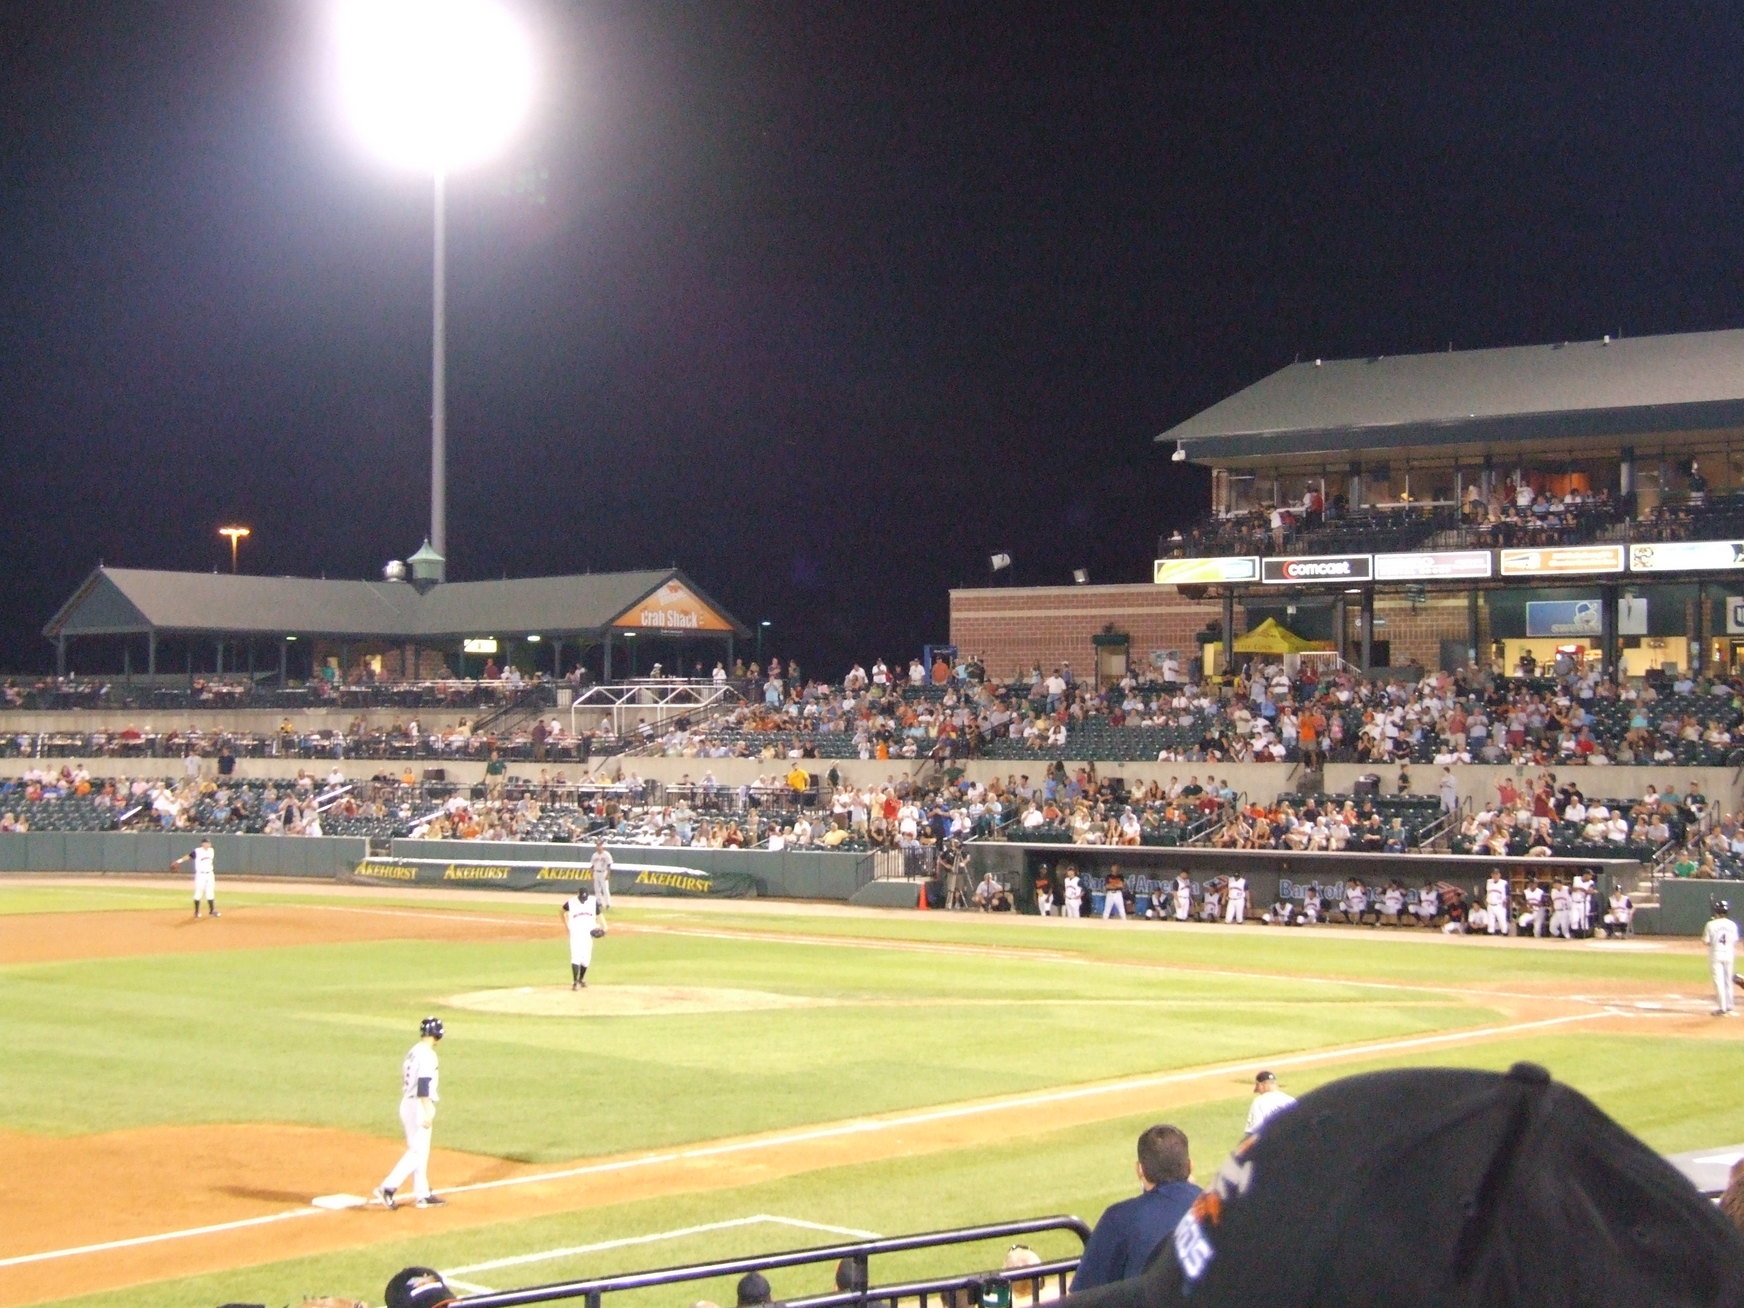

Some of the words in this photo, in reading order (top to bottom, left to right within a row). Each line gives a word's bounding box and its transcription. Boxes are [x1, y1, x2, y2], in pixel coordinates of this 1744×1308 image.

[641, 610, 665, 627] Crab
[667, 609, 699, 628] Shack
[536, 867, 593, 881] AKEHUR
